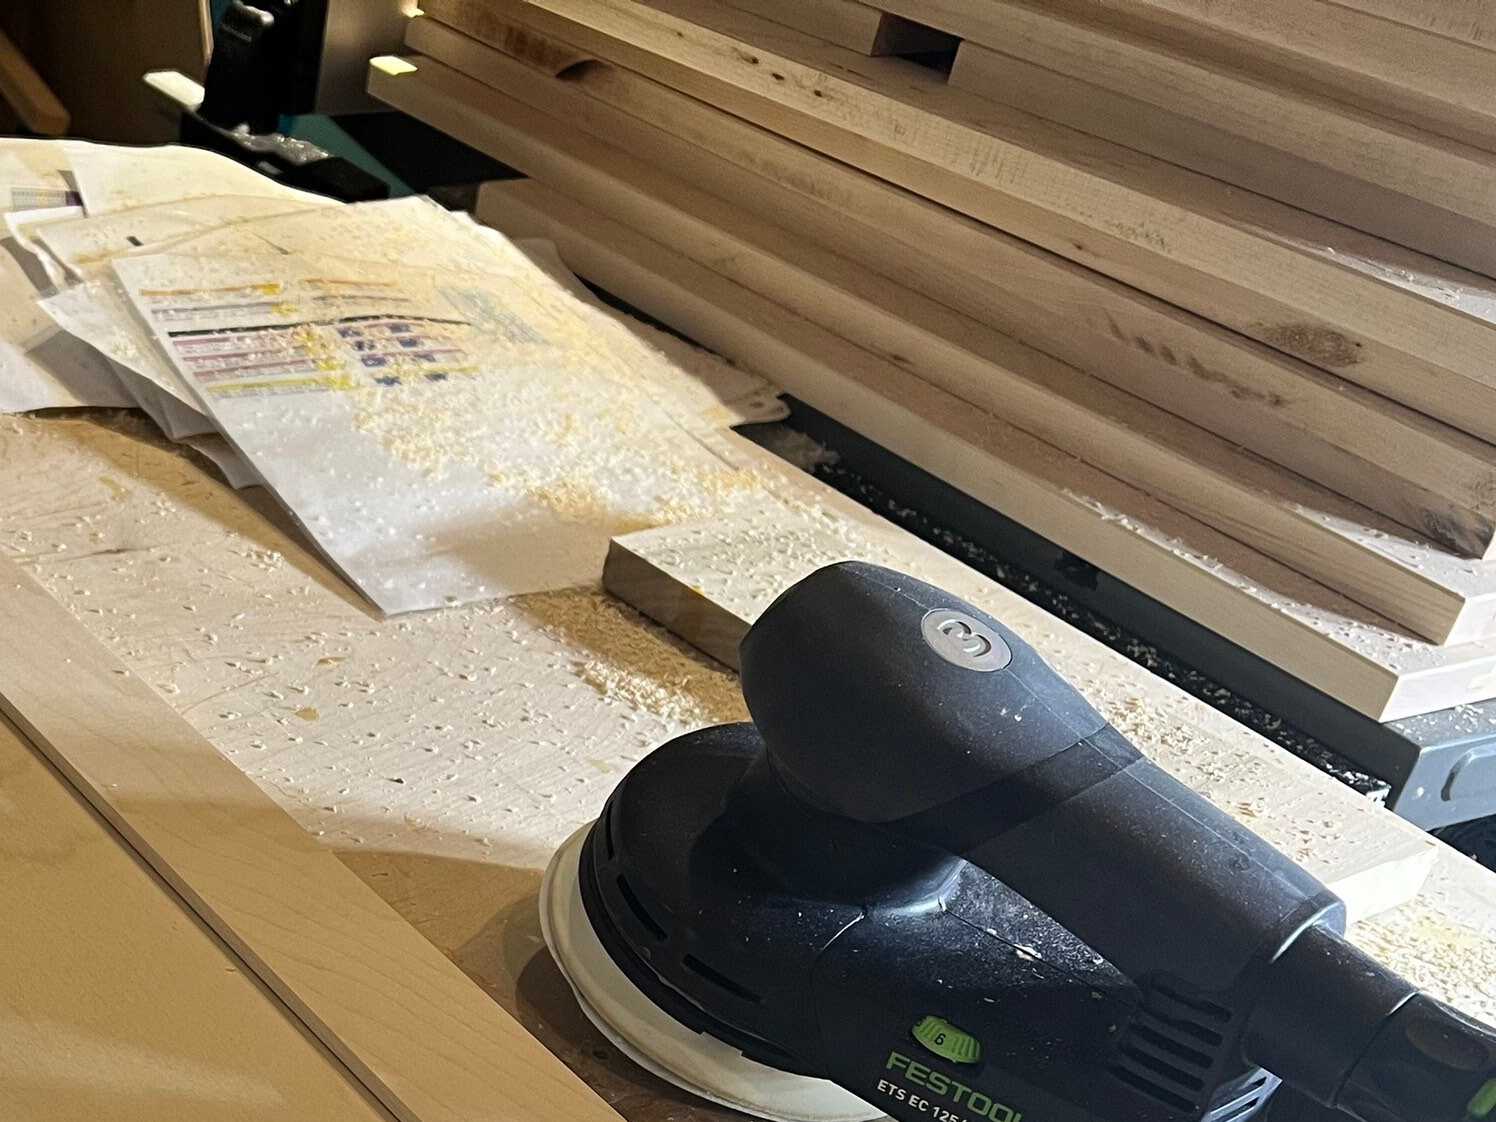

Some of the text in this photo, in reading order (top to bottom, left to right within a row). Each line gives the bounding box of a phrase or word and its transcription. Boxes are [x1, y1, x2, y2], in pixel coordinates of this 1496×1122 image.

[934, 1033, 947, 1046] 6
[877, 1079, 907, 1101] ETS
[908, 1095, 929, 1112] EC
